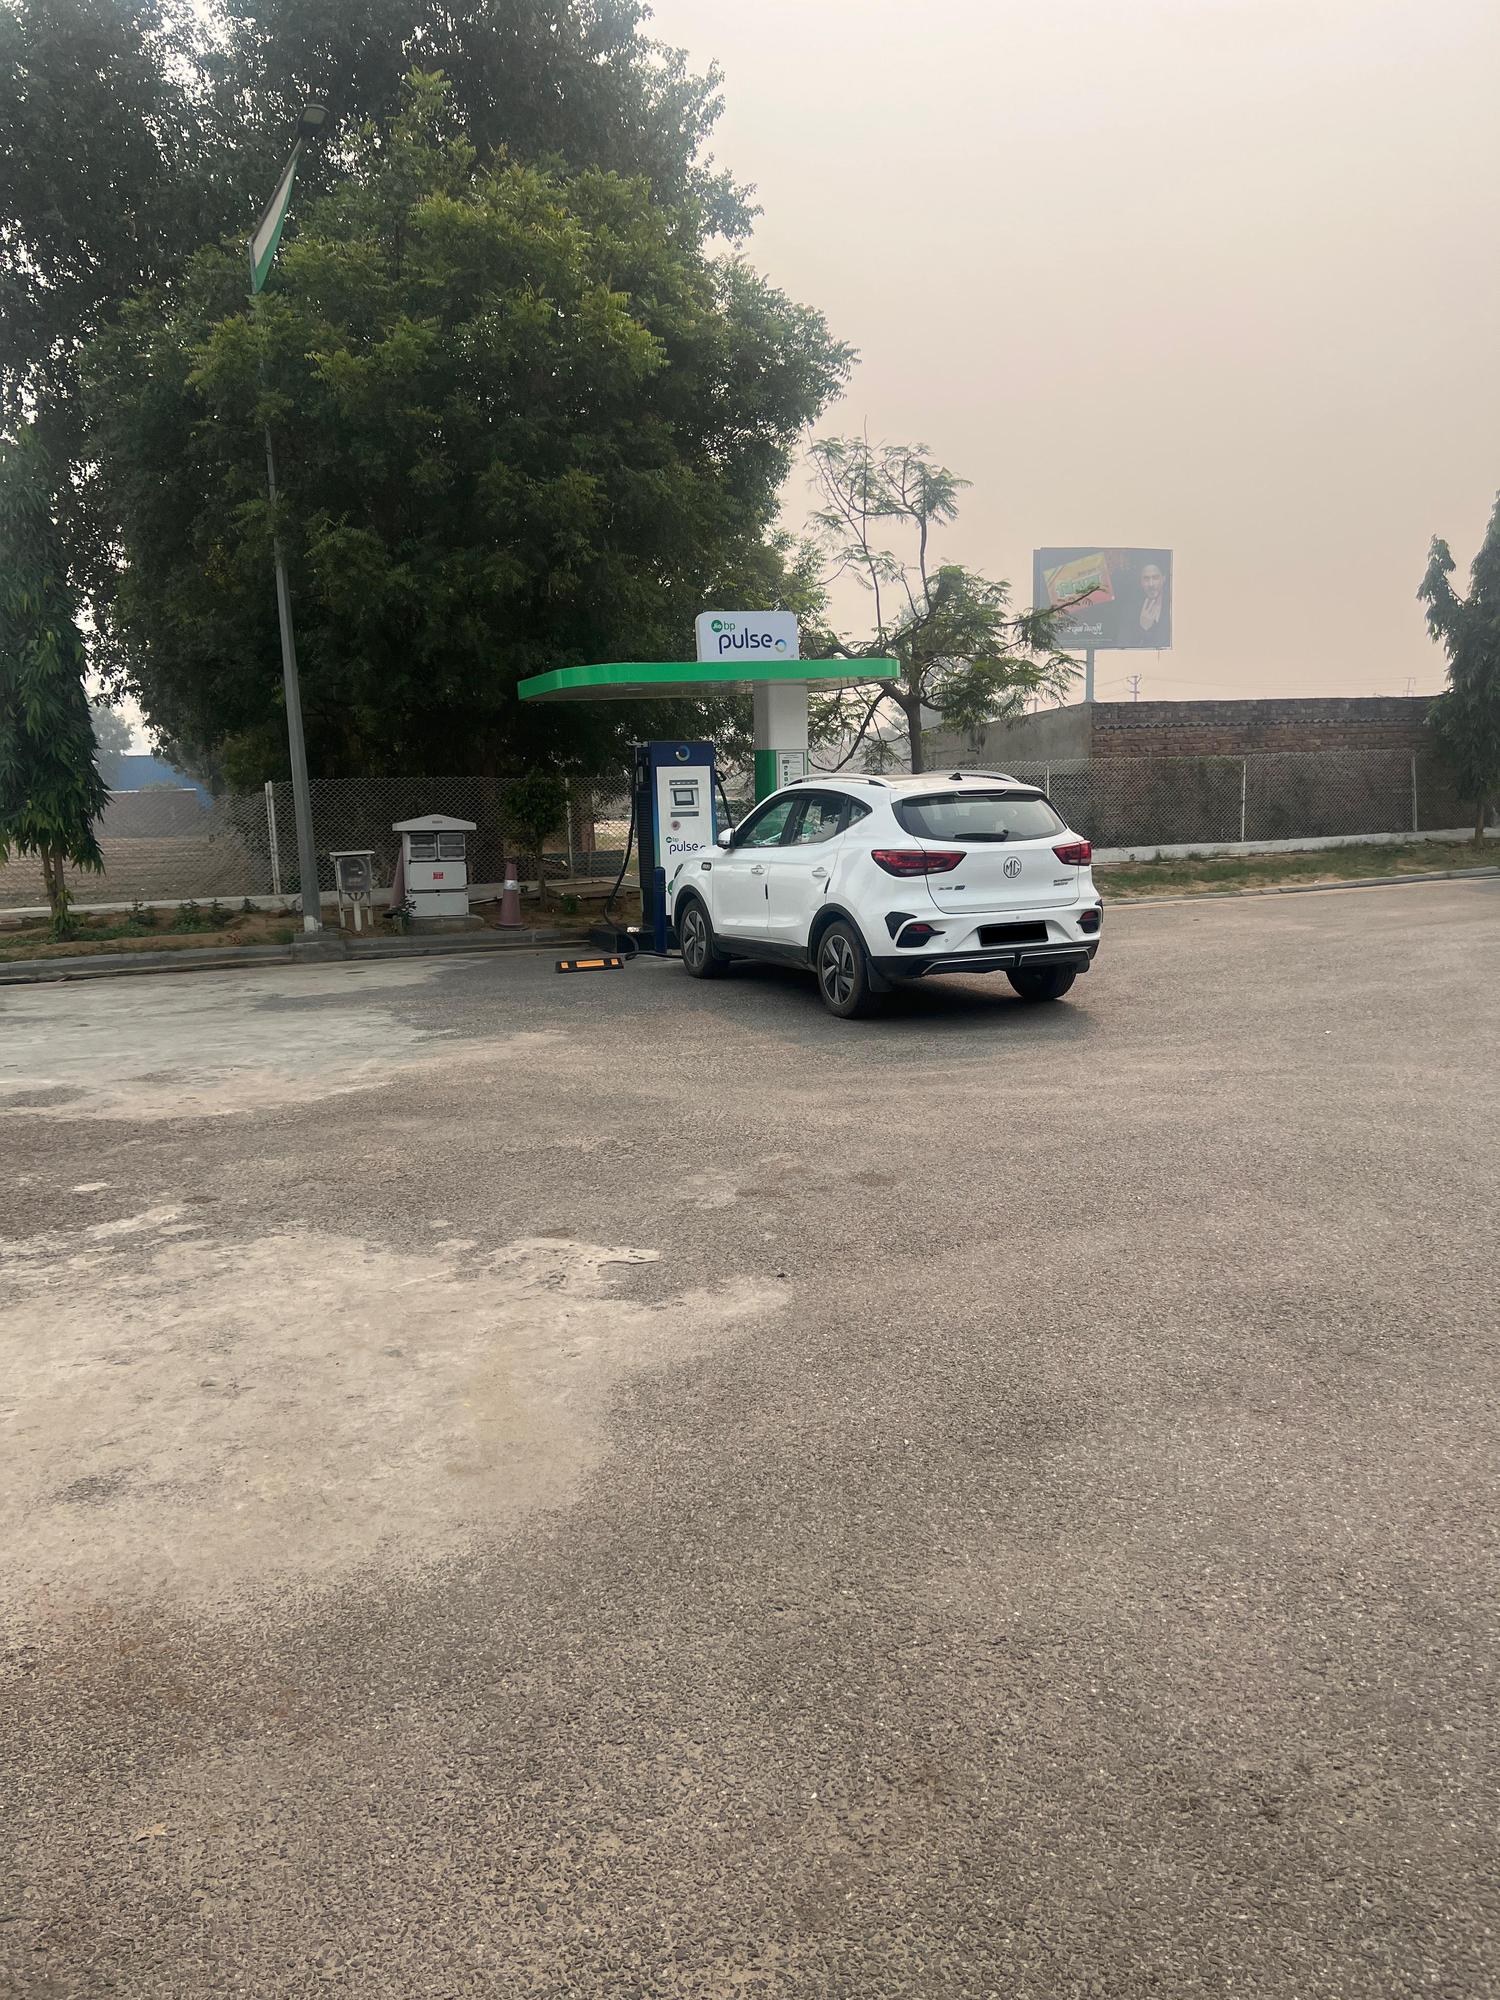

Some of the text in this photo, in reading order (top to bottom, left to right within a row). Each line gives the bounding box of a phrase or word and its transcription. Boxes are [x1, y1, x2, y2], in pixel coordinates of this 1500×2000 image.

[723, 621, 736, 632] bp
[718, 628, 773, 654] pulse
[669, 841, 699, 855] pulse
